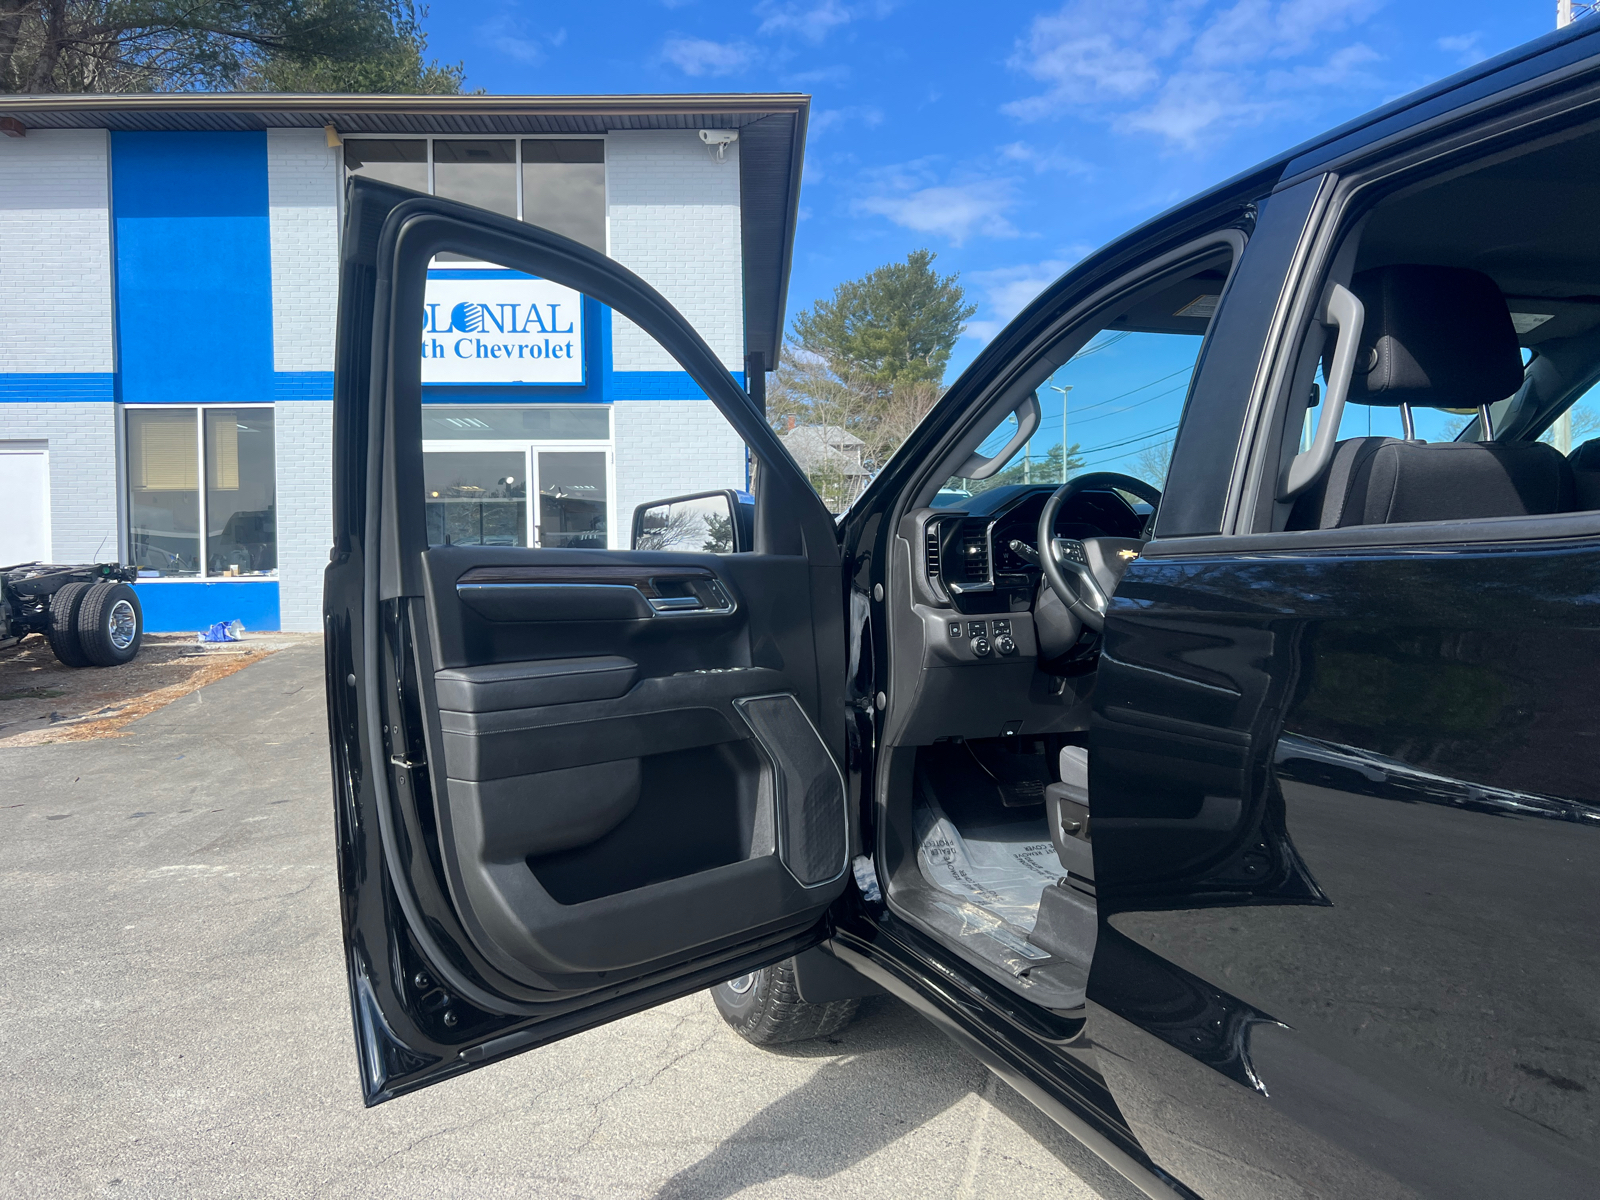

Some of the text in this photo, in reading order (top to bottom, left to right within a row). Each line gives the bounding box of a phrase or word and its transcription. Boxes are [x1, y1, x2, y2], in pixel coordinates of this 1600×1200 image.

[422, 301, 574, 333] LONIAL
[454, 338, 574, 359] Chevrolet
[930, 848, 957, 857] DEALER
[1023, 844, 1047, 852] COVER
[1013, 850, 1043, 858] REMOVE
